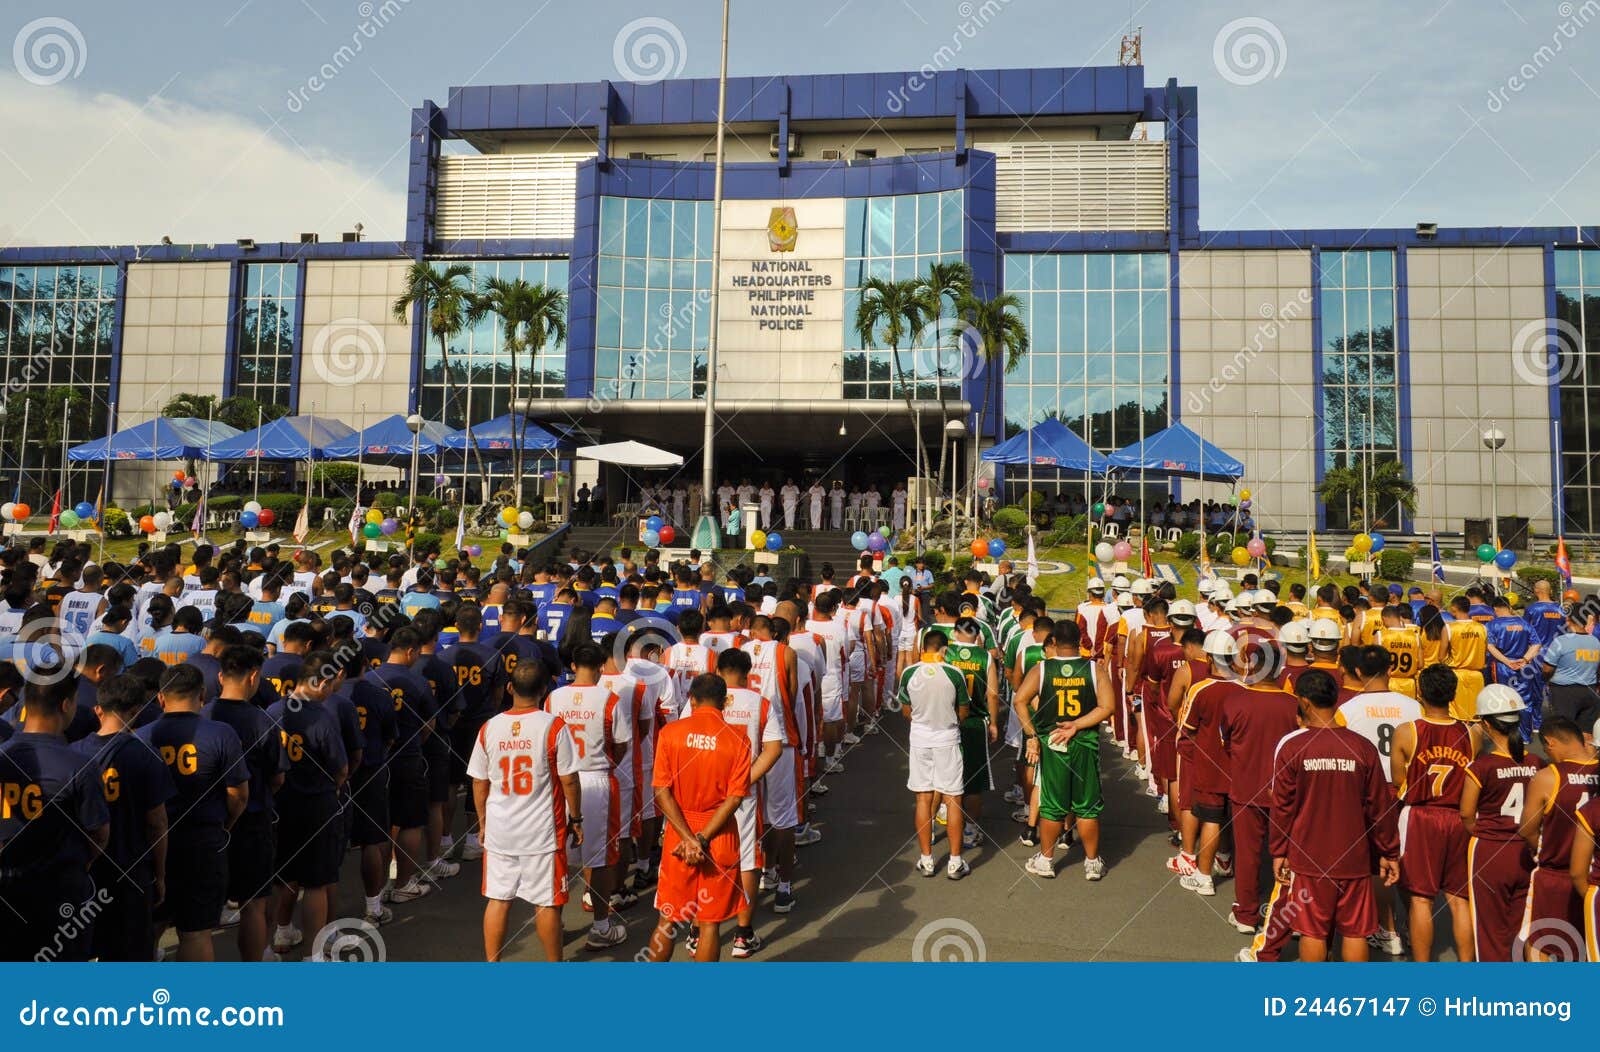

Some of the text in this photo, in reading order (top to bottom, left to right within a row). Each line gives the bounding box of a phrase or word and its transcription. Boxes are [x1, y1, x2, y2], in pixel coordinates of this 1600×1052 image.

[752, 261, 812, 272] NATIONAL
[732, 275, 832, 287] HEADQUARTERS
[749, 290, 814, 301] PHILIPPINE
[751, 305, 812, 316] NATIONAL
[759, 319, 804, 330] POLICE
[63, 611, 89, 634] 15
[548, 618, 561, 641] 7
[452, 665, 482, 687] PG
[1053, 677, 1086, 686] MIRANDA
[1056, 689, 1082, 717] 15
[559, 710, 596, 720] NAPILOY
[499, 739, 532, 751] RAMOS
[687, 733, 717, 751] CHESS
[1377, 723, 1395, 757] 8
[1303, 758, 1356, 772] SHOOTING TEAM
[1417, 745, 1470, 768] FABROS
[499, 755, 533, 796] 16
[1427, 764, 1454, 797] 7
[0, 783, 43, 820] PG
[1501, 783, 1524, 825] 4
